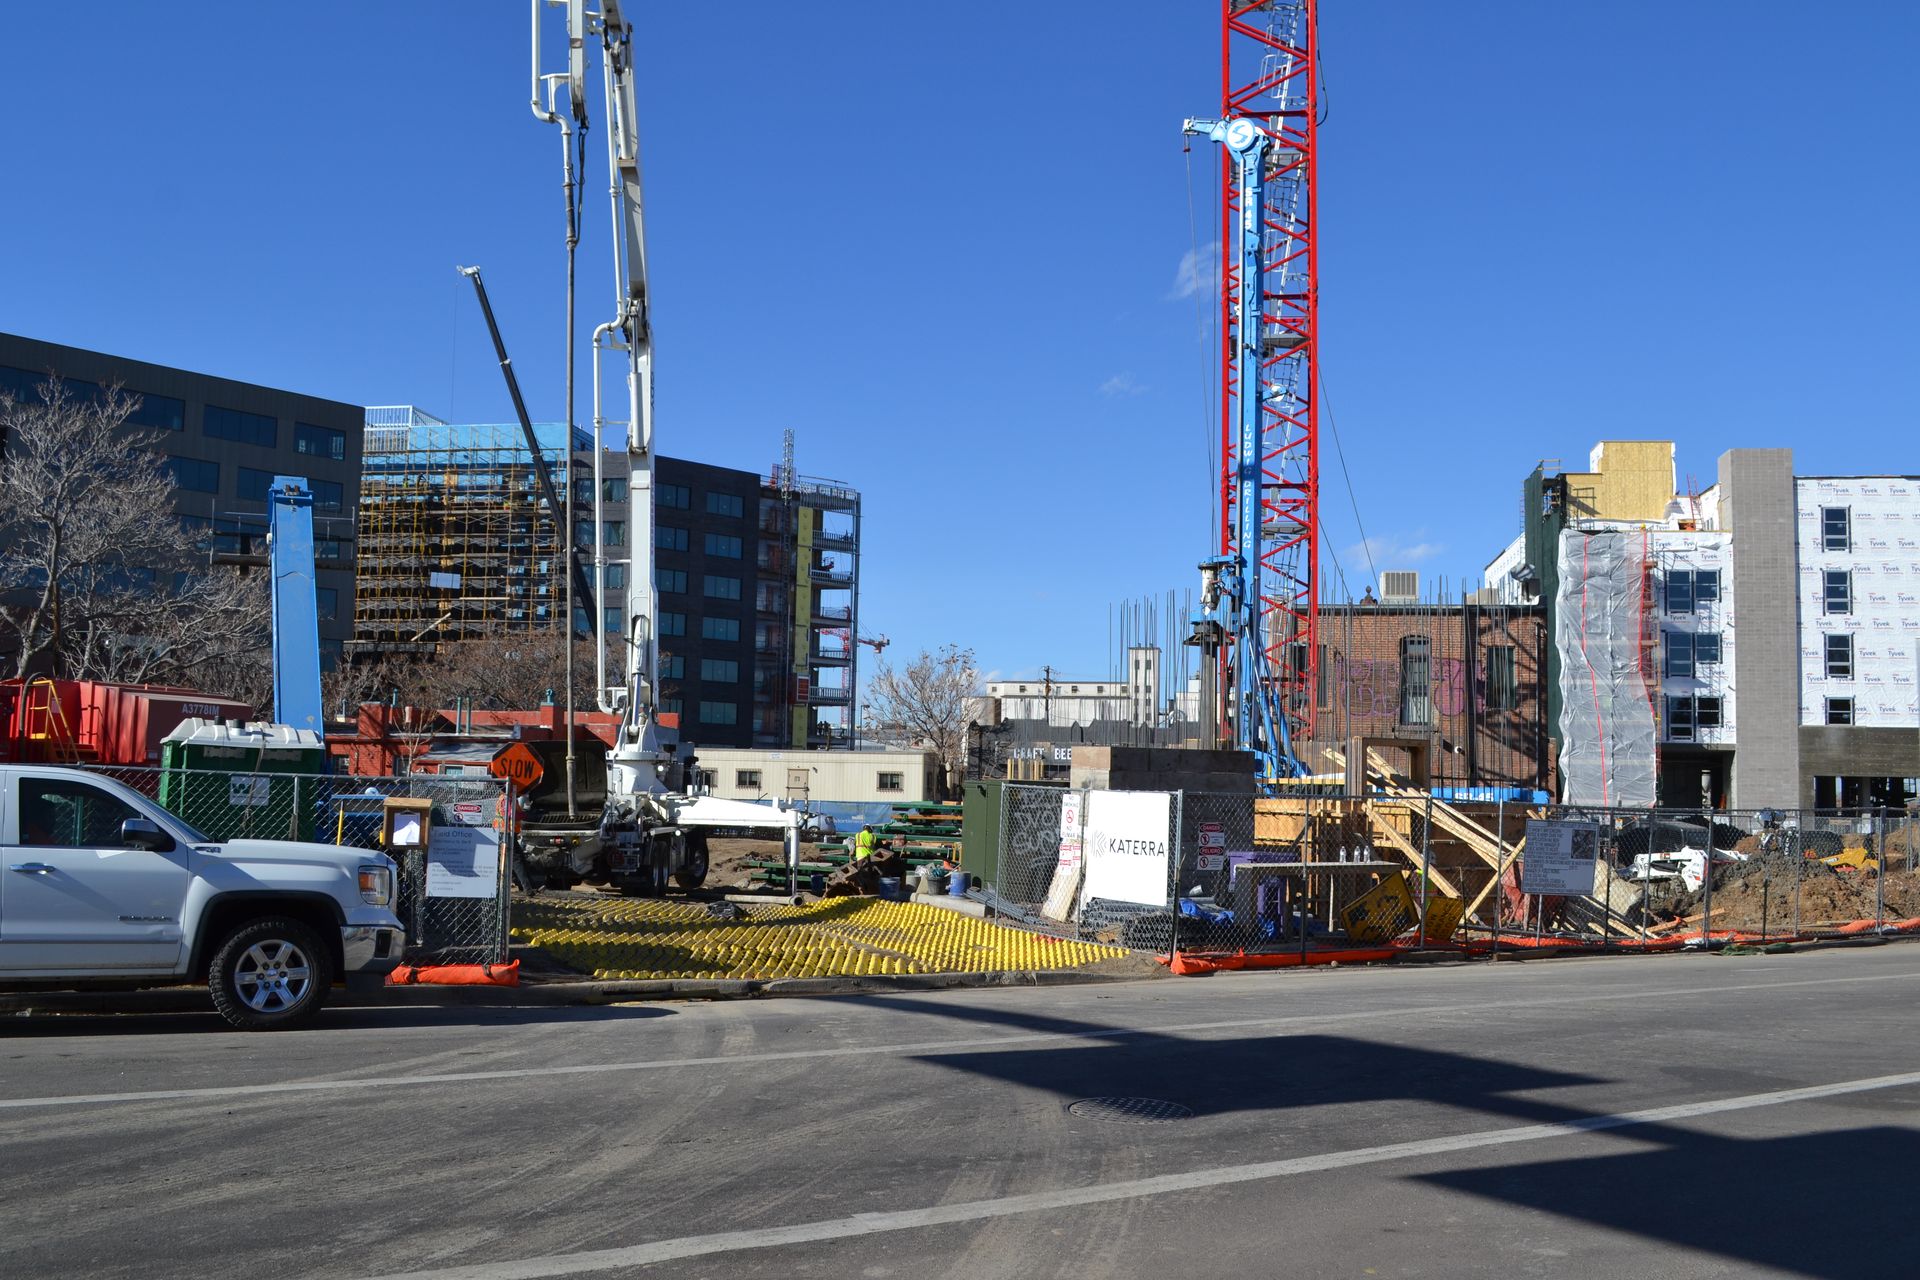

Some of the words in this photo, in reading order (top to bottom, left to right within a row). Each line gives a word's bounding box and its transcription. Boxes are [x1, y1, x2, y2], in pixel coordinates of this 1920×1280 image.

[1244, 424, 1252, 474] LUDWIG
[1243, 481, 1251, 548] DRILLING
[500, 758, 534, 778] SLOW
[1109, 838, 1166, 857] KATERRA
